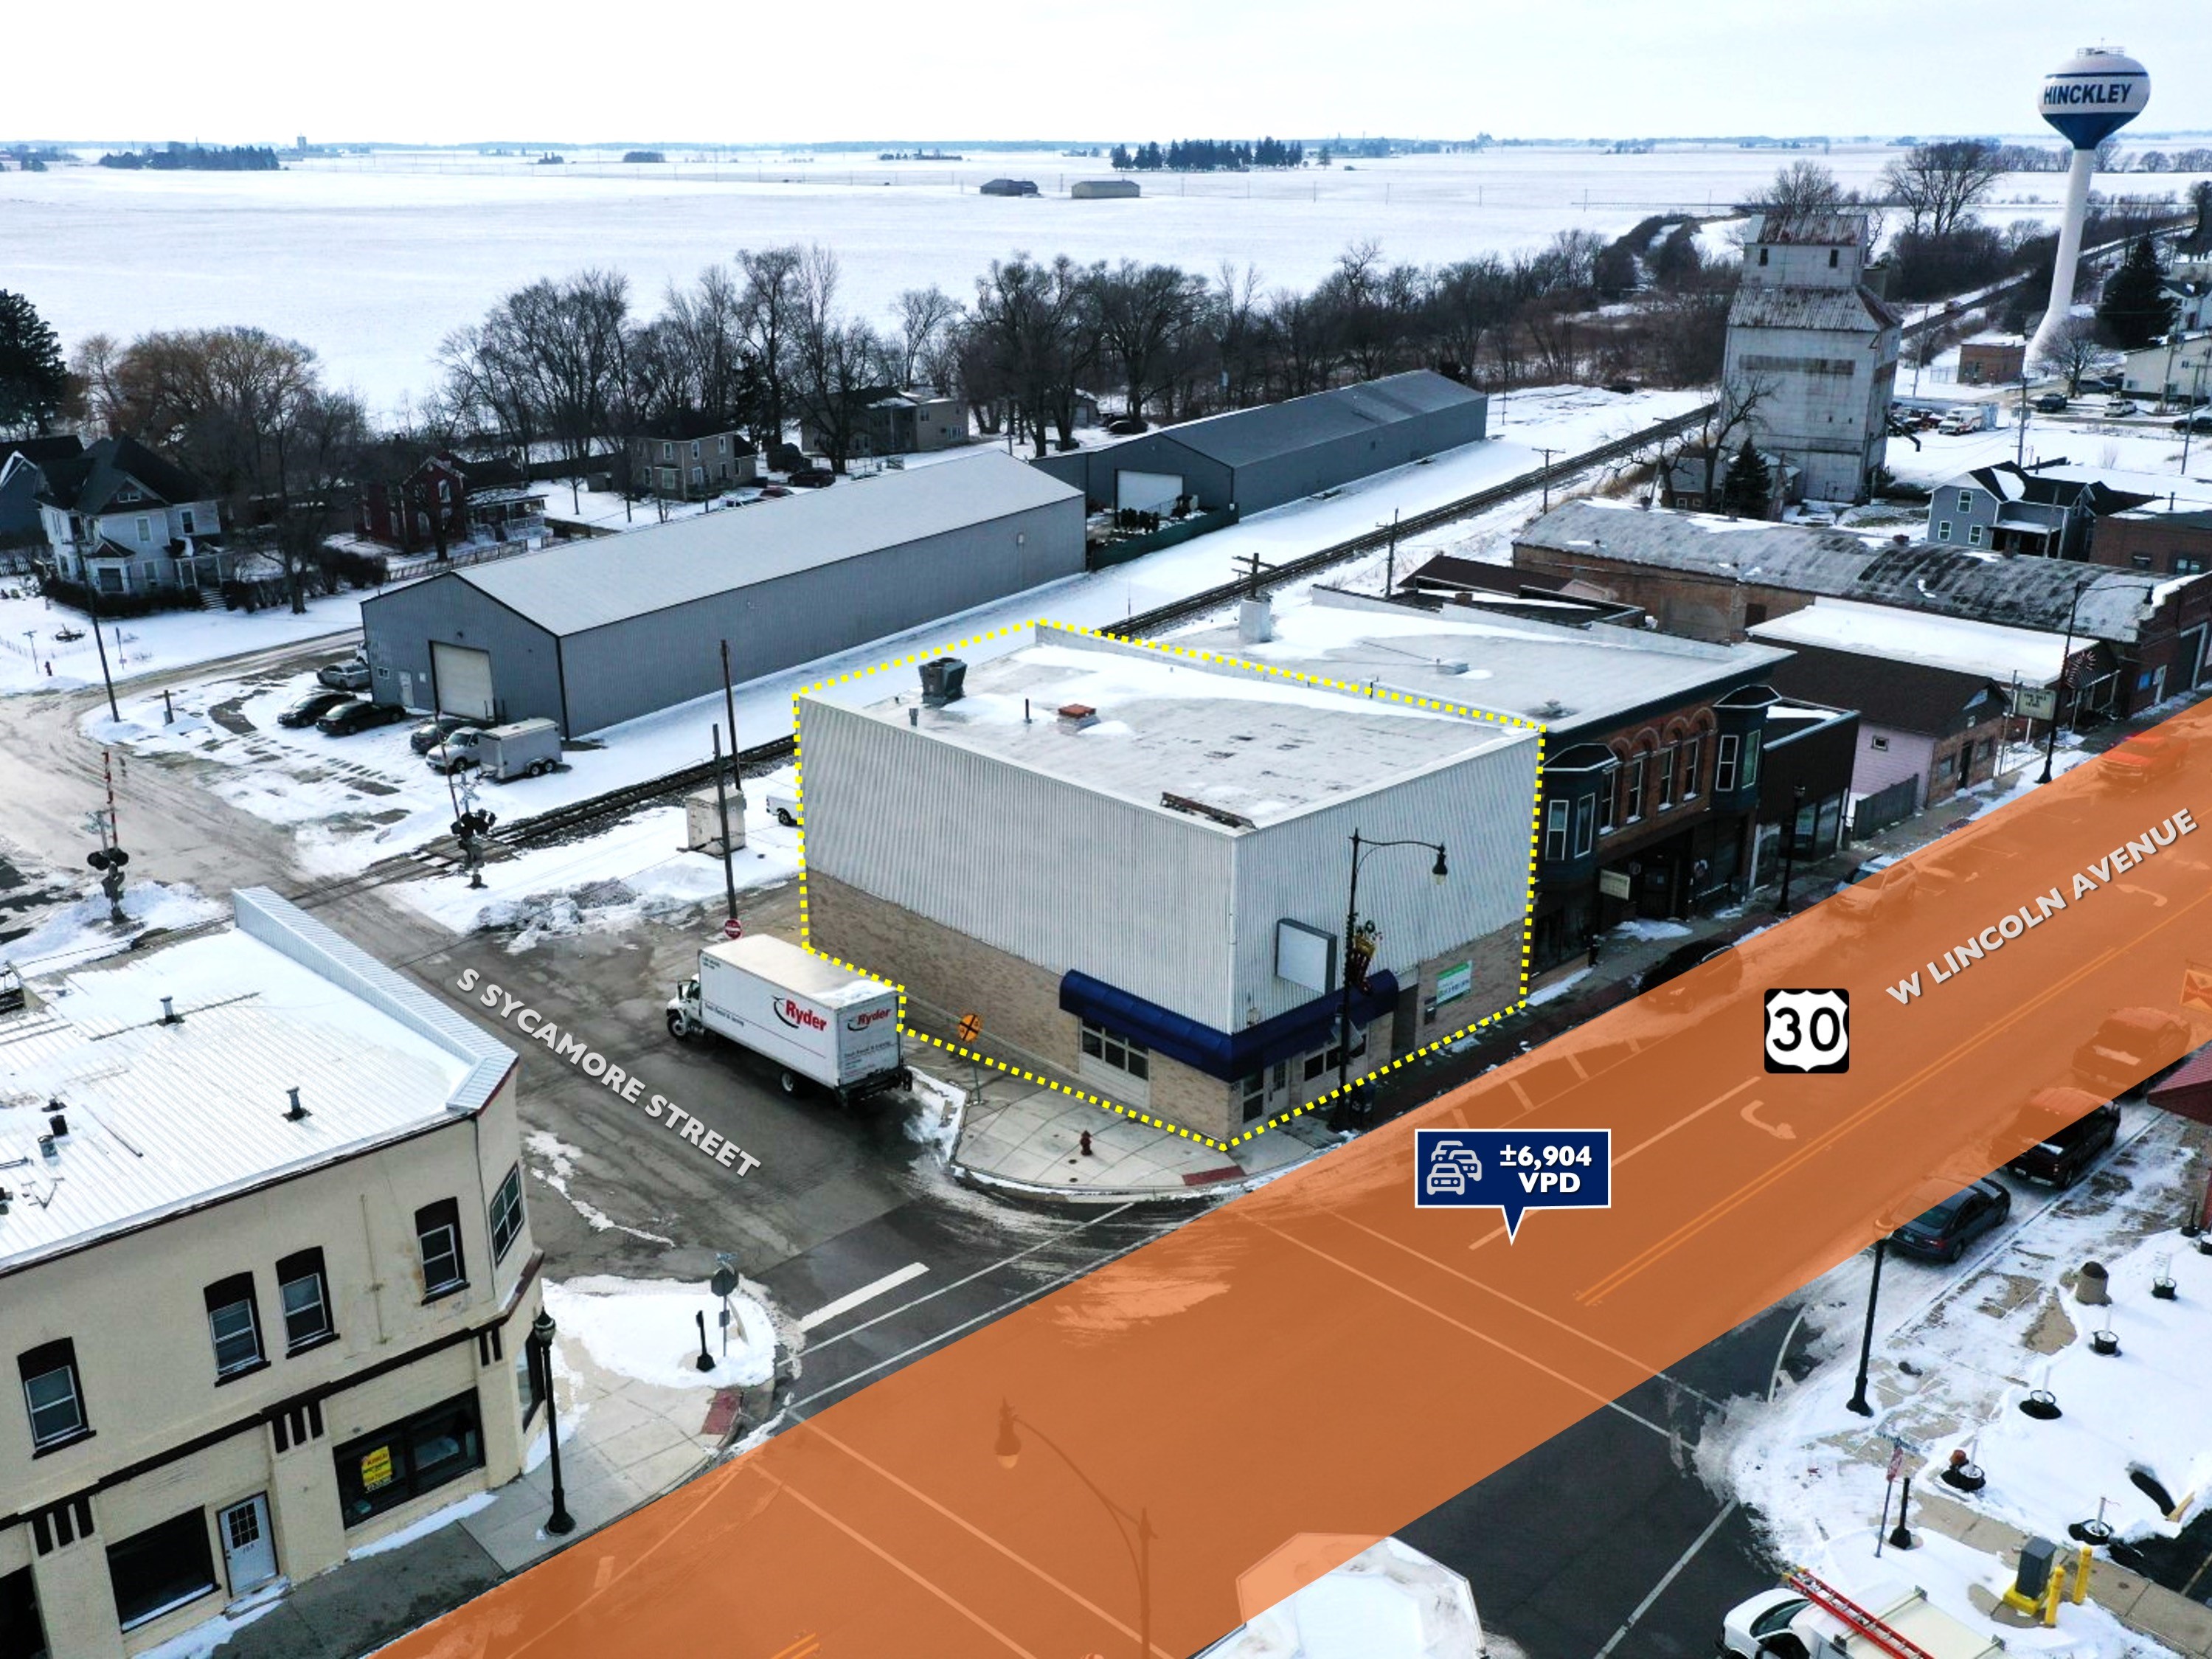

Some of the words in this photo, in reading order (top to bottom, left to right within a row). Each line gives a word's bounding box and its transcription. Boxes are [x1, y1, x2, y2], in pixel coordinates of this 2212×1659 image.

[2044, 84, 2132, 105] HINCKLEY
[786, 1000, 827, 1031] Ryder
[857, 1008, 892, 1025] Ryder
